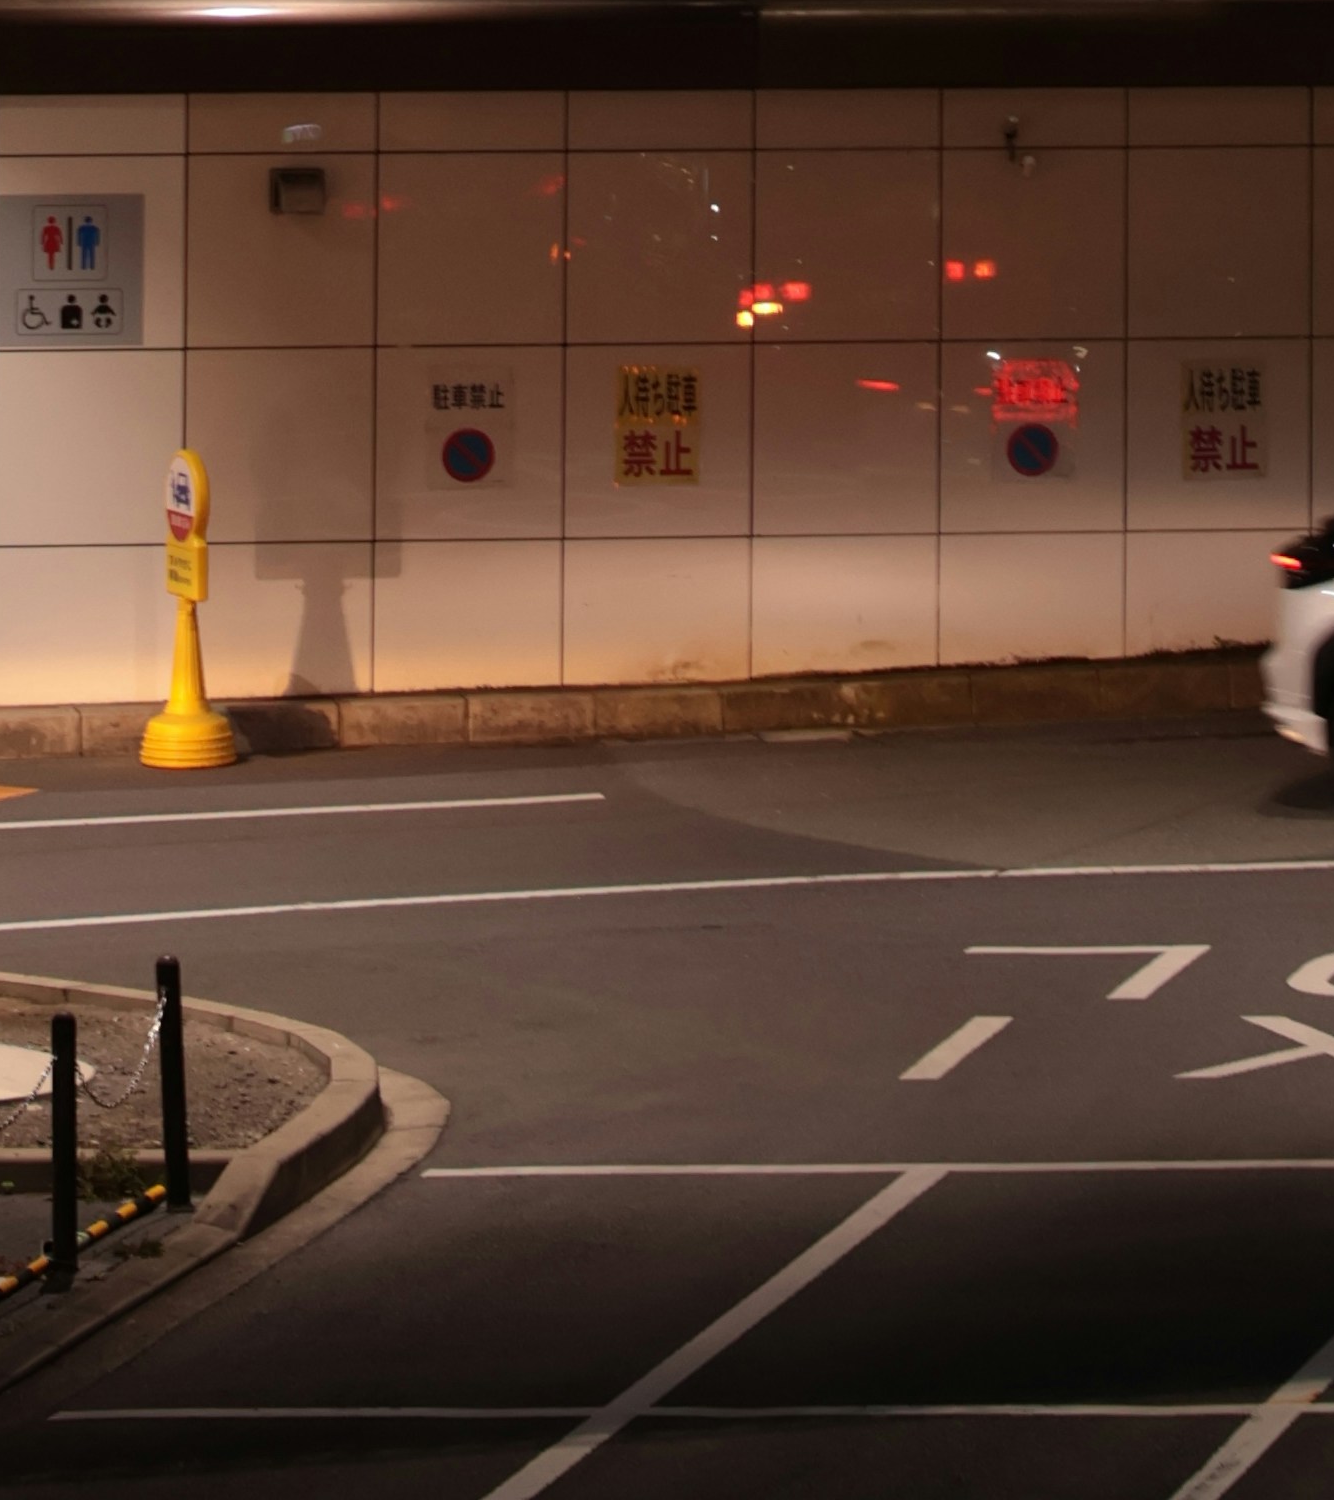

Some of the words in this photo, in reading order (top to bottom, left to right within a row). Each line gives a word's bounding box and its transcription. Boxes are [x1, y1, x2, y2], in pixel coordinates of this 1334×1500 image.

[432, 383, 505, 411] 駐車禁止
[618, 373, 698, 418] 人待ち駐車
[1183, 367, 1262, 414] 人待ち駐車
[622, 429, 694, 478] 禁止
[1189, 424, 1260, 473] 禁止
